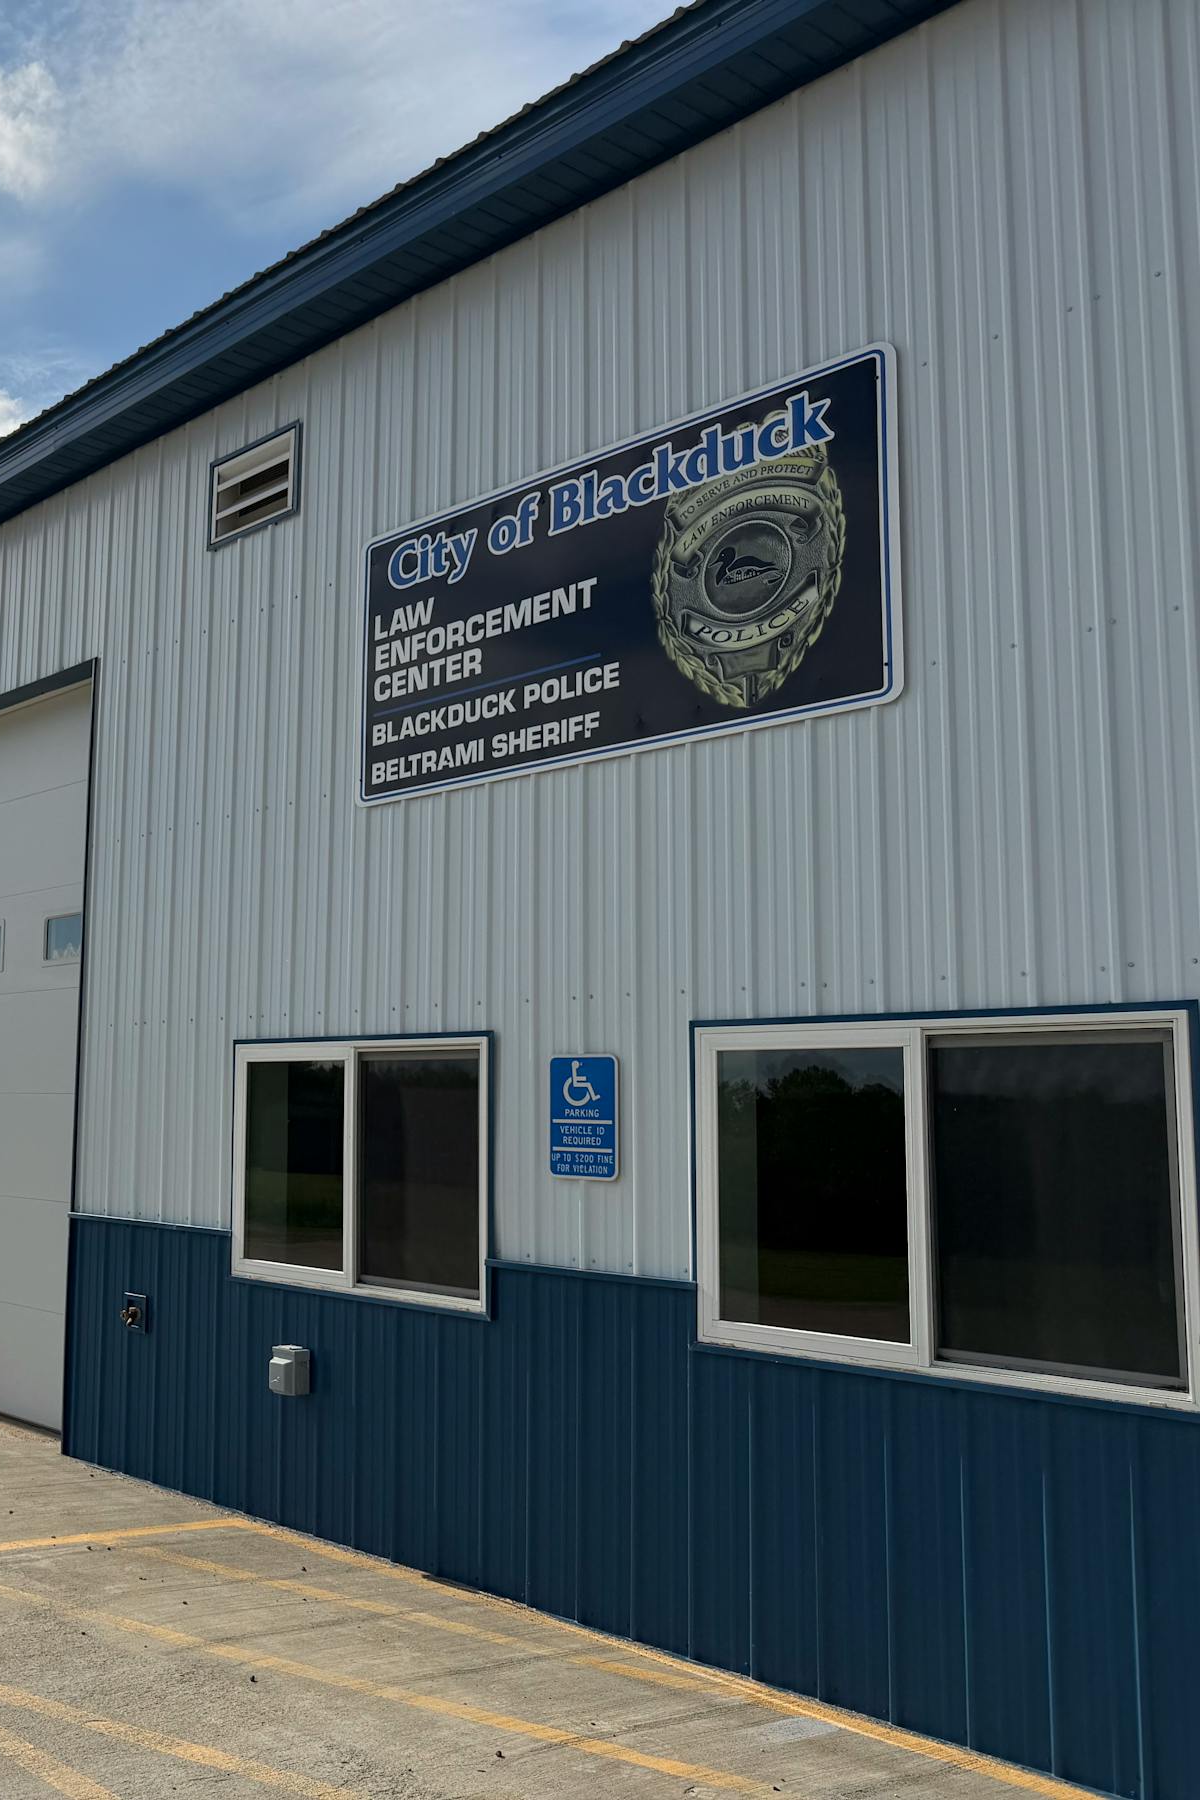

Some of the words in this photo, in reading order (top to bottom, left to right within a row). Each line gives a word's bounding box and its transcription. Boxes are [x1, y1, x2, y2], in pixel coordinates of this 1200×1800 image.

[388, 528, 477, 590] City
[488, 492, 539, 555] of
[548, 390, 835, 536] Blackduck
[680, 505, 695, 521] TO
[696, 480, 730, 507] SERVE
[733, 469, 757, 484] AND
[760, 464, 814, 476] PROTECT
[682, 521, 708, 551] LAW
[711, 494, 810, 526] ENFORCEMENT
[374, 596, 434, 640] LAW
[374, 577, 597, 671] ENFORCEMENT
[693, 598, 809, 643] POLICE
[374, 648, 482, 702] CENTER
[372, 689, 515, 747] BLACKDUCK
[523, 662, 620, 710] POLICE
[371, 738, 484, 785] BELTRAMI
[491, 712, 600, 758] SHERIFF
[560, 1126, 592, 1135] VEHICLE
[596, 1127, 605, 1135] ID
[565, 1109, 599, 1117] PARKING
[551, 1153, 560, 1161] UP
[564, 1153, 571, 1162] TO
[598, 1155, 613, 1164] FINE
[563, 1136, 601, 1145] REQUIRED
[557, 1163, 569, 1172] FOR
[573, 1165, 608, 1174] VIOLATION
